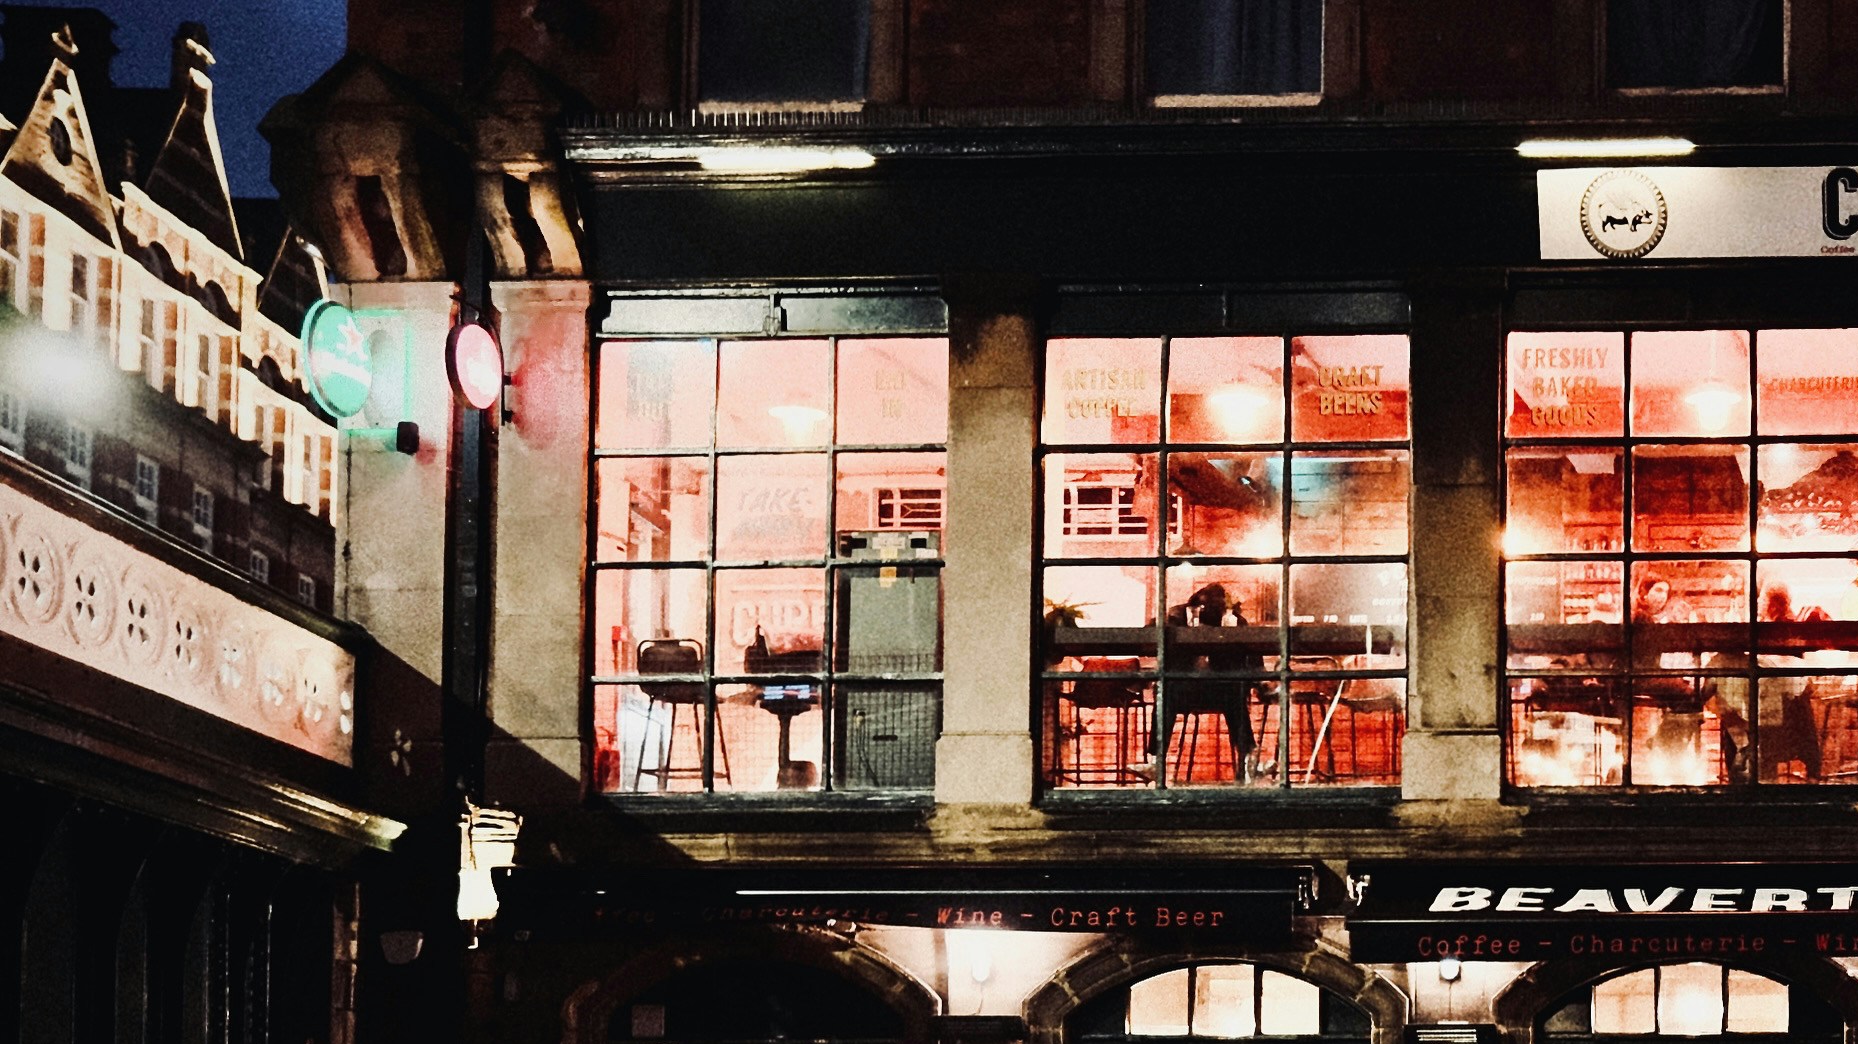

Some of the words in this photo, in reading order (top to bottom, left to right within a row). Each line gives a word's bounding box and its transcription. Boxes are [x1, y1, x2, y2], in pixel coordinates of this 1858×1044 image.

[1820, 245, 1855, 254] Coffee
[1522, 348, 1608, 369] FRESHLY
[1318, 365, 1384, 387] CRAFT
[1319, 393, 1383, 415] BEERS
[1531, 404, 1598, 427] GOODS
[937, 907, 1003, 925] Wine
[1051, 907, 1137, 927] Craft
[1156, 907, 1224, 927] Beer
[1418, 935, 1521, 956] Coffee
[1570, 933, 1765, 954] Charcuterie
